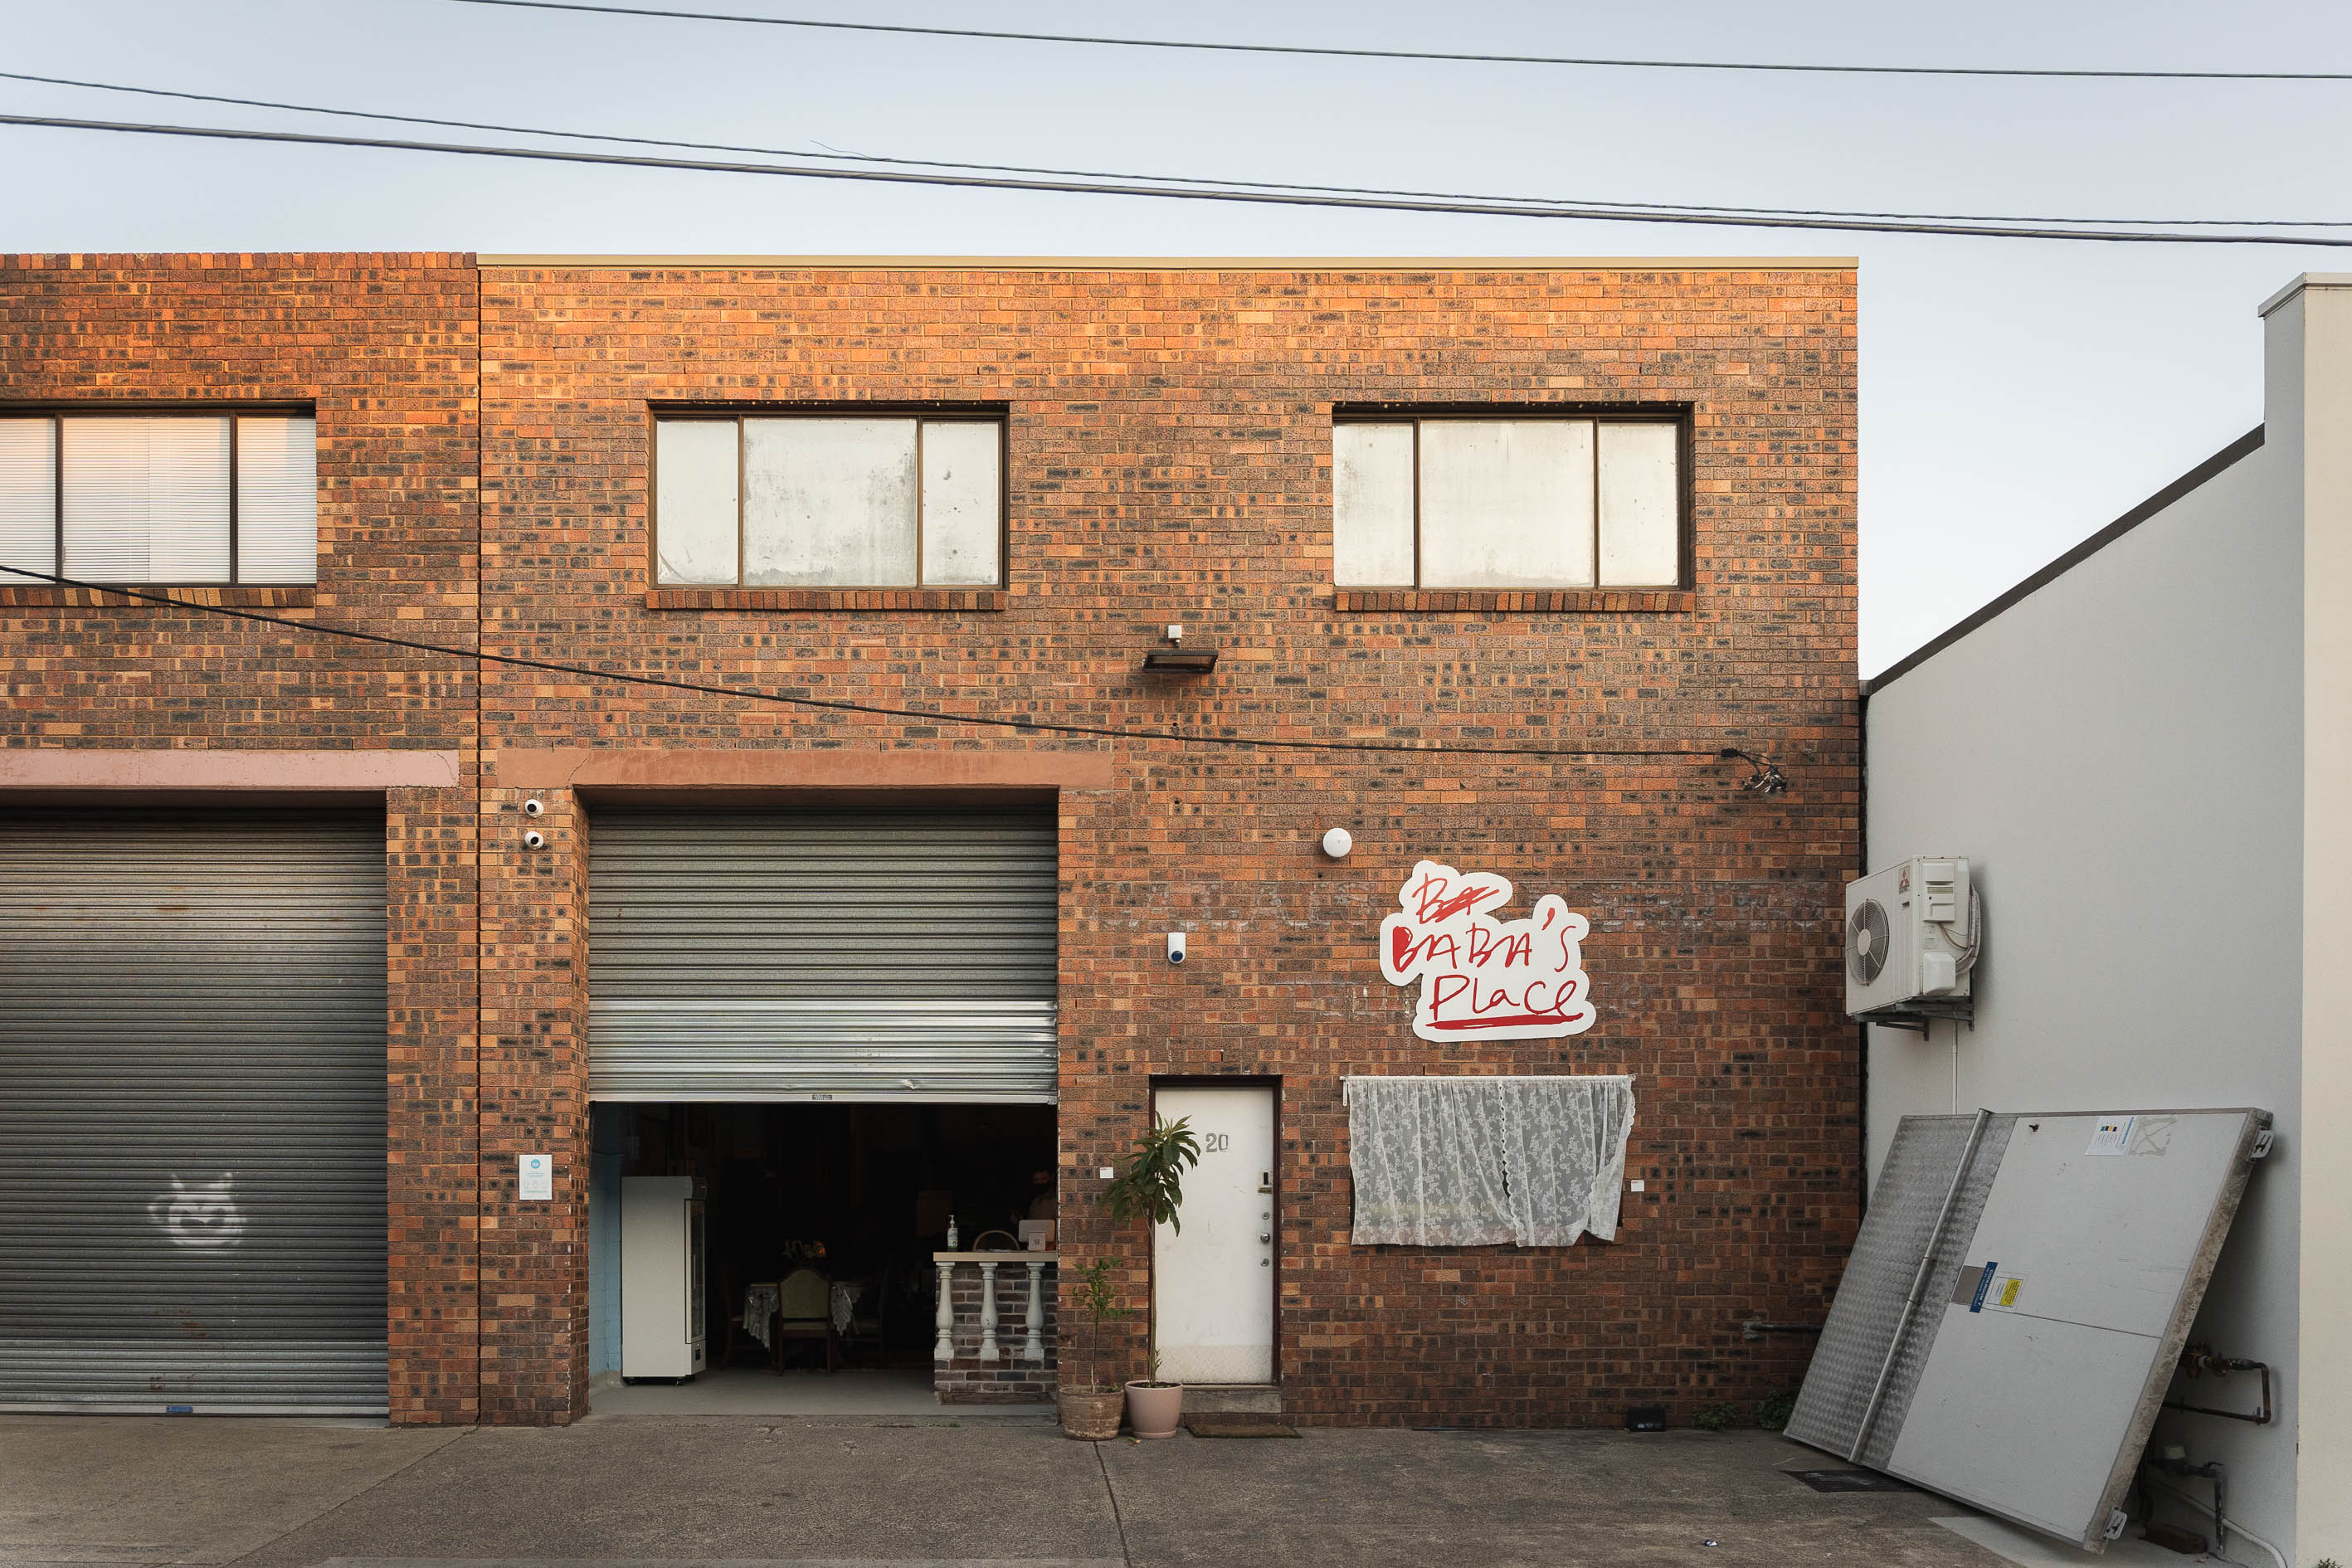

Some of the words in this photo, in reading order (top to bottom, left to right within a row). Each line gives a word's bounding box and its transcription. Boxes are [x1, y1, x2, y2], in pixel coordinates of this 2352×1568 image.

[1429, 974, 1578, 1020] Place
[1205, 1132, 1229, 1152] 20
[1979, 1269, 1994, 1301] COOLROOM
